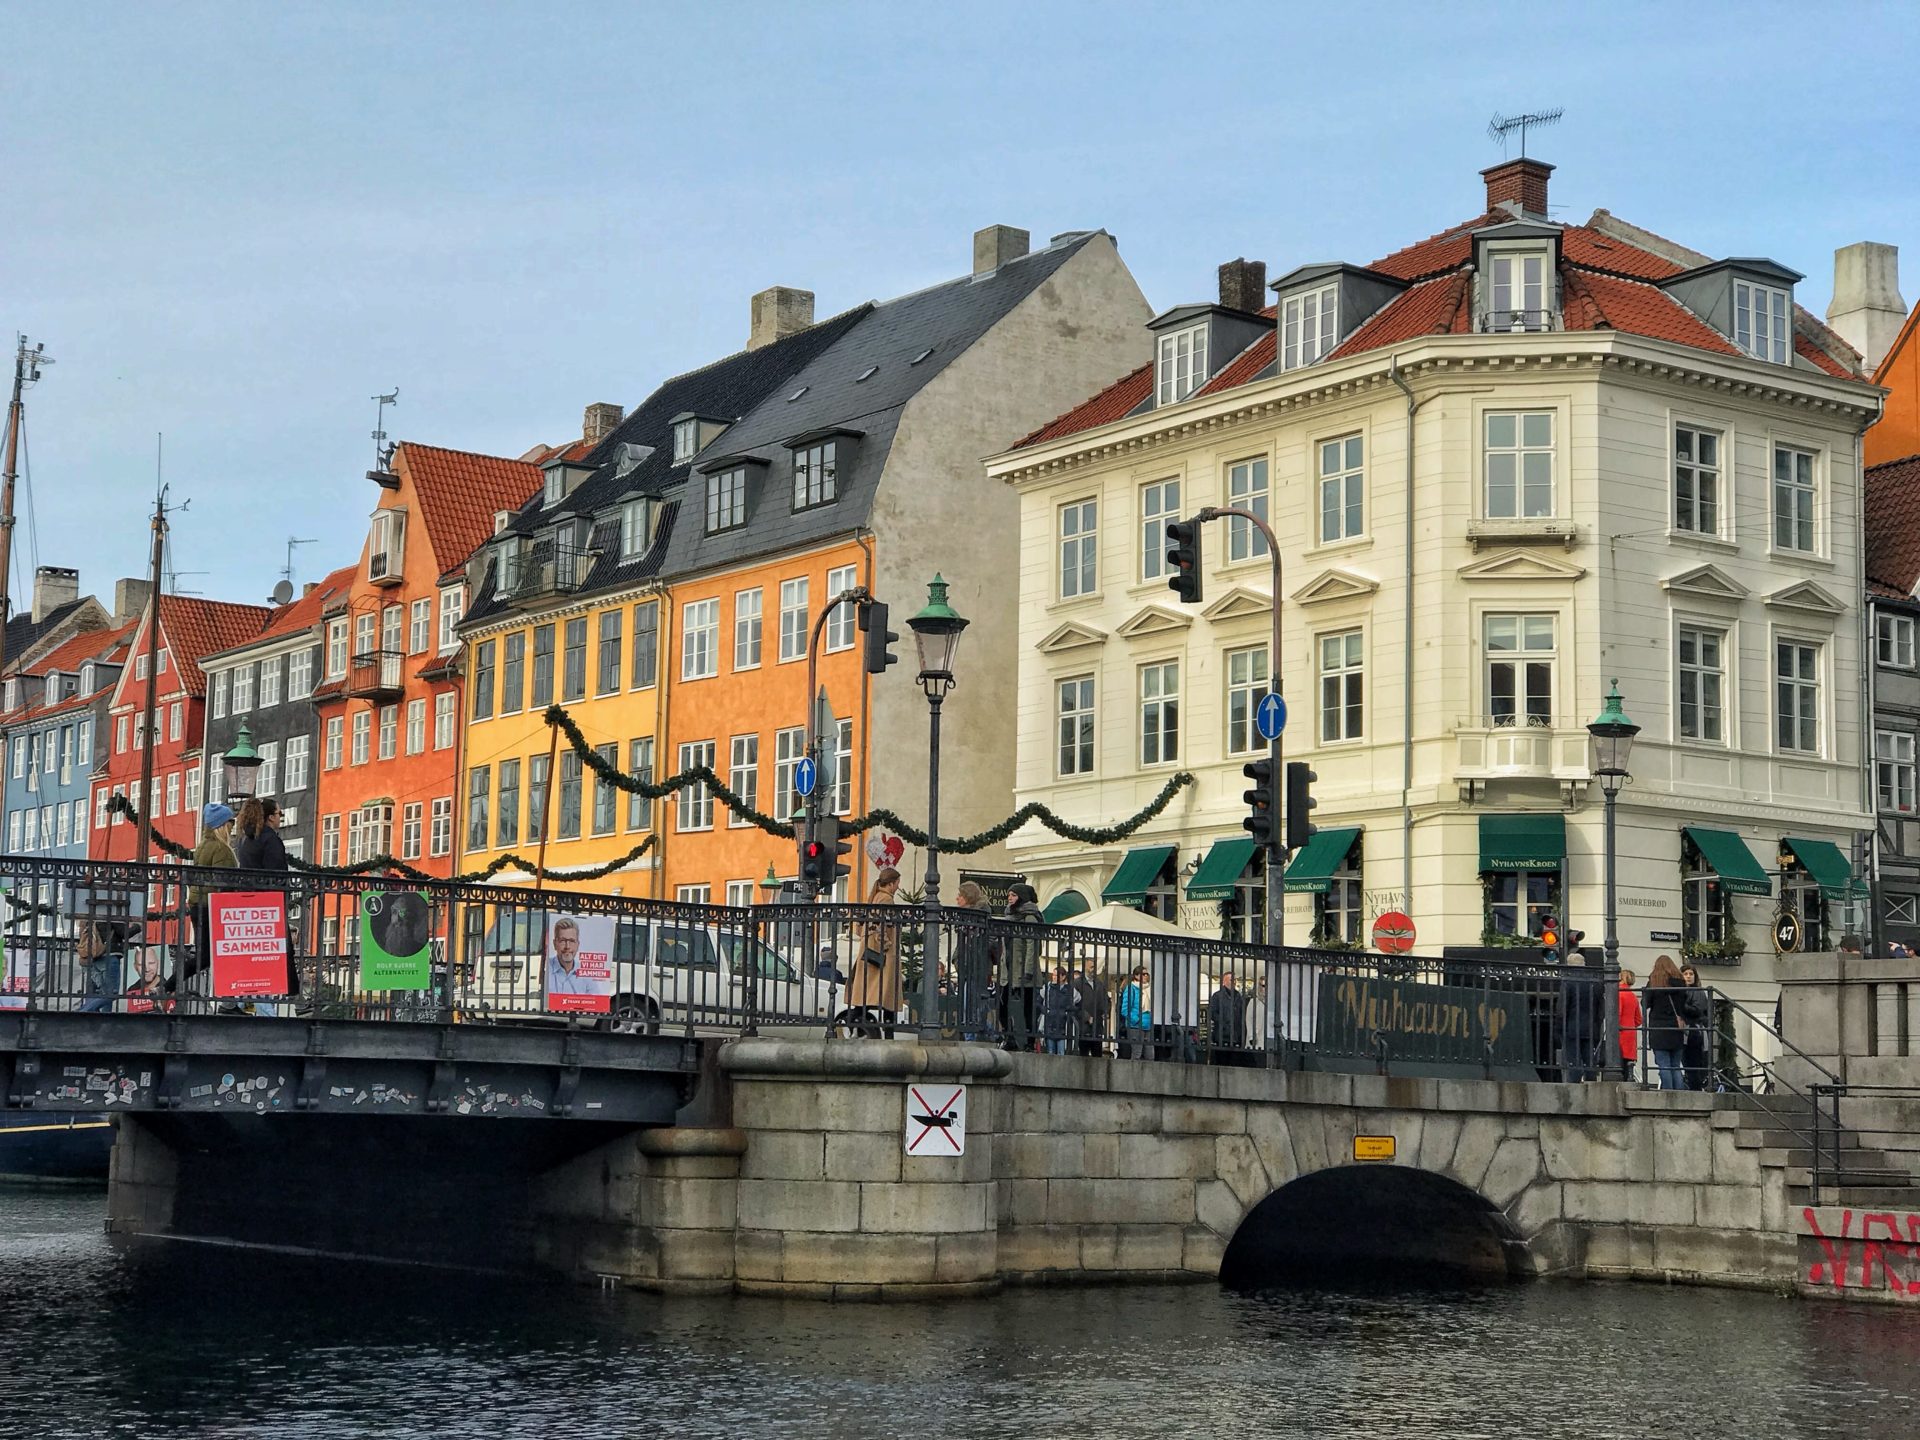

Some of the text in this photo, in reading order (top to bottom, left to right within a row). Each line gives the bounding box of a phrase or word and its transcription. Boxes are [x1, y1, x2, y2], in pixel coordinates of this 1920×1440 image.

[1491, 859, 1557, 868] NYHAVNSKROEN
[981, 885, 1008, 896] NYHAV
[1284, 882, 1326, 890] NYHAVNSKROEN
[1191, 890, 1231, 898] NYHAVNSKROEN
[1618, 897, 1667, 908] SMØRREBRØD
[223, 909, 277, 921] ALT DET
[1179, 904, 1217, 918] NYHAVN
[1184, 918, 1215, 930] KROEN
[227, 925, 273, 937] VI HAR
[1779, 926, 1795, 941] 47
[222, 941, 280, 953] SAMMEN
